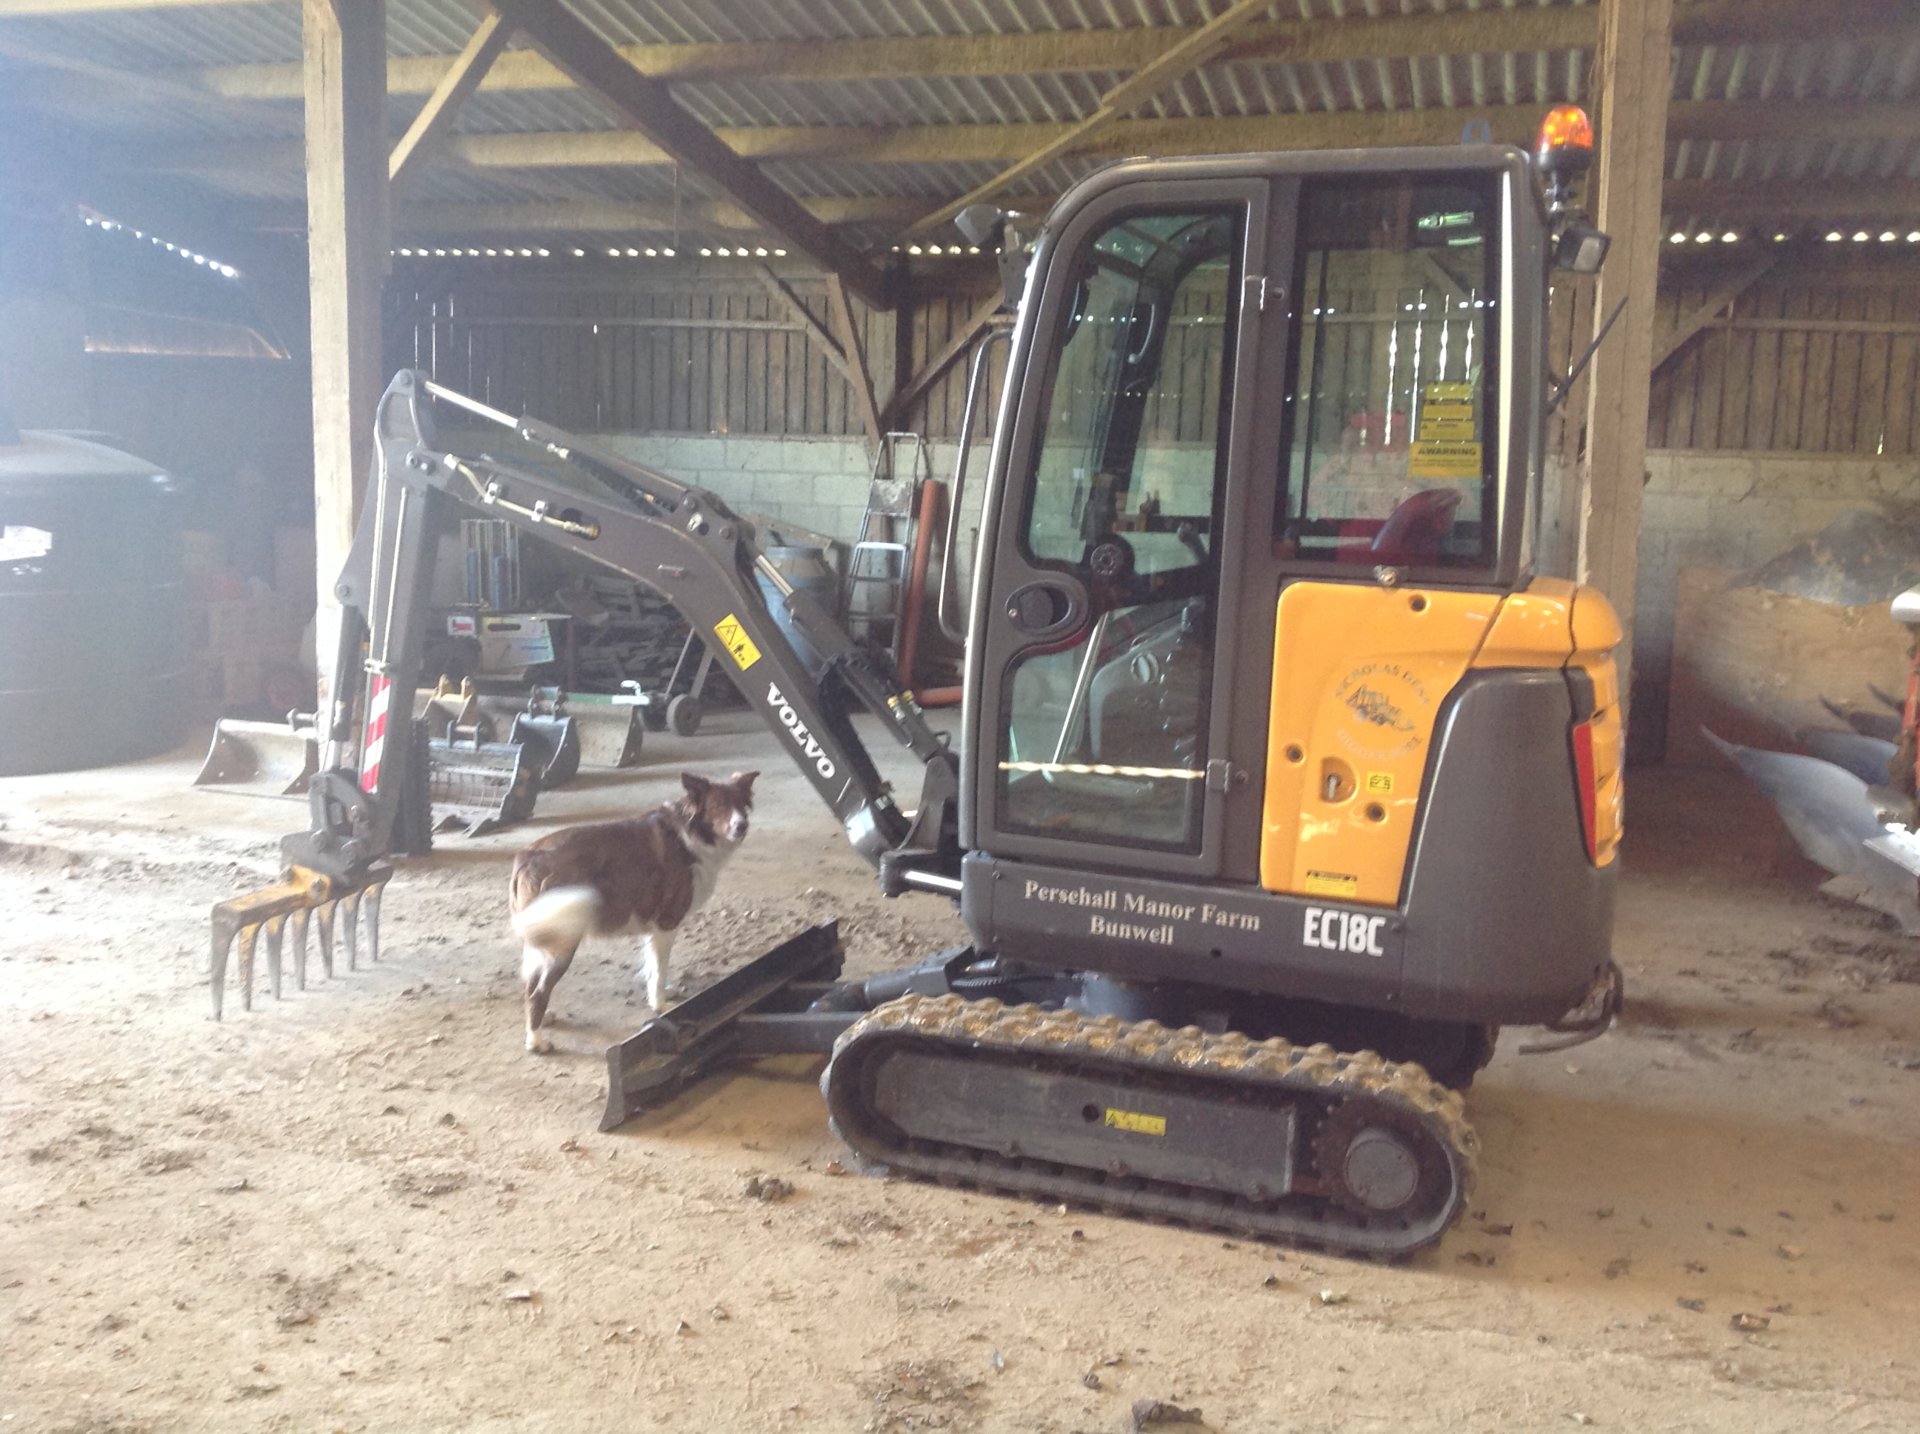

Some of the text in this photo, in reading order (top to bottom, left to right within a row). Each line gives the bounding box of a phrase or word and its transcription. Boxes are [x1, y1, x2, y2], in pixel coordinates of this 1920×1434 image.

[1425, 447, 1477, 456] WARNING
[766, 681, 836, 779] VOLVO
[1090, 914, 1174, 945] Bunwell
[1123, 892, 1196, 920] Manor
[1201, 903, 1261, 932] Farm
[1302, 906, 1387, 957] EC18C
